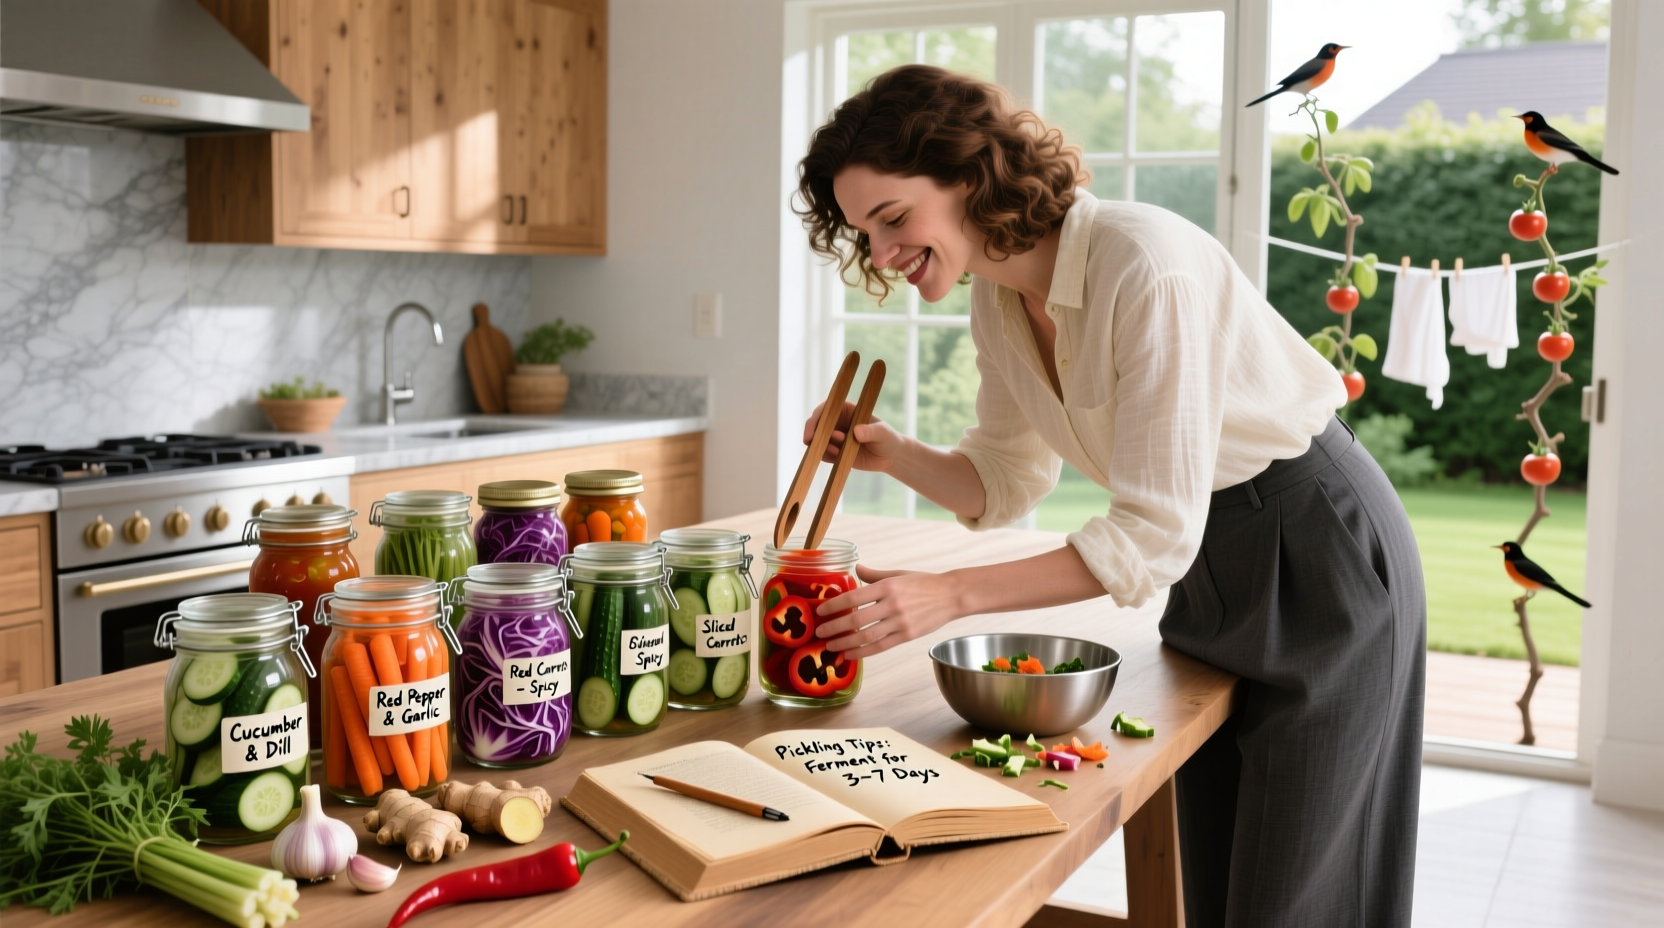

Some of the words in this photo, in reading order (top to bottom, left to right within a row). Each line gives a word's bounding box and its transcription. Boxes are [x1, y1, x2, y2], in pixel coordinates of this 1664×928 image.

[701, 617, 736, 634] Sliced
[510, 662, 533, 679] Red
[376, 689, 403, 709] Red
[407, 687, 446, 707] Pepper
[382, 710, 395, 726] &
[401, 707, 440, 724] Garlic
[229, 714, 303, 742] Cucumber
[244, 743, 259, 762] &
[265, 734, 291, 760] Dill
[774, 741, 845, 760] Pickling
[844, 738, 891, 754] Tips:
[804, 755, 877, 774] Ferment
[881, 752, 908, 766] for
[891, 767, 940, 784] Days
